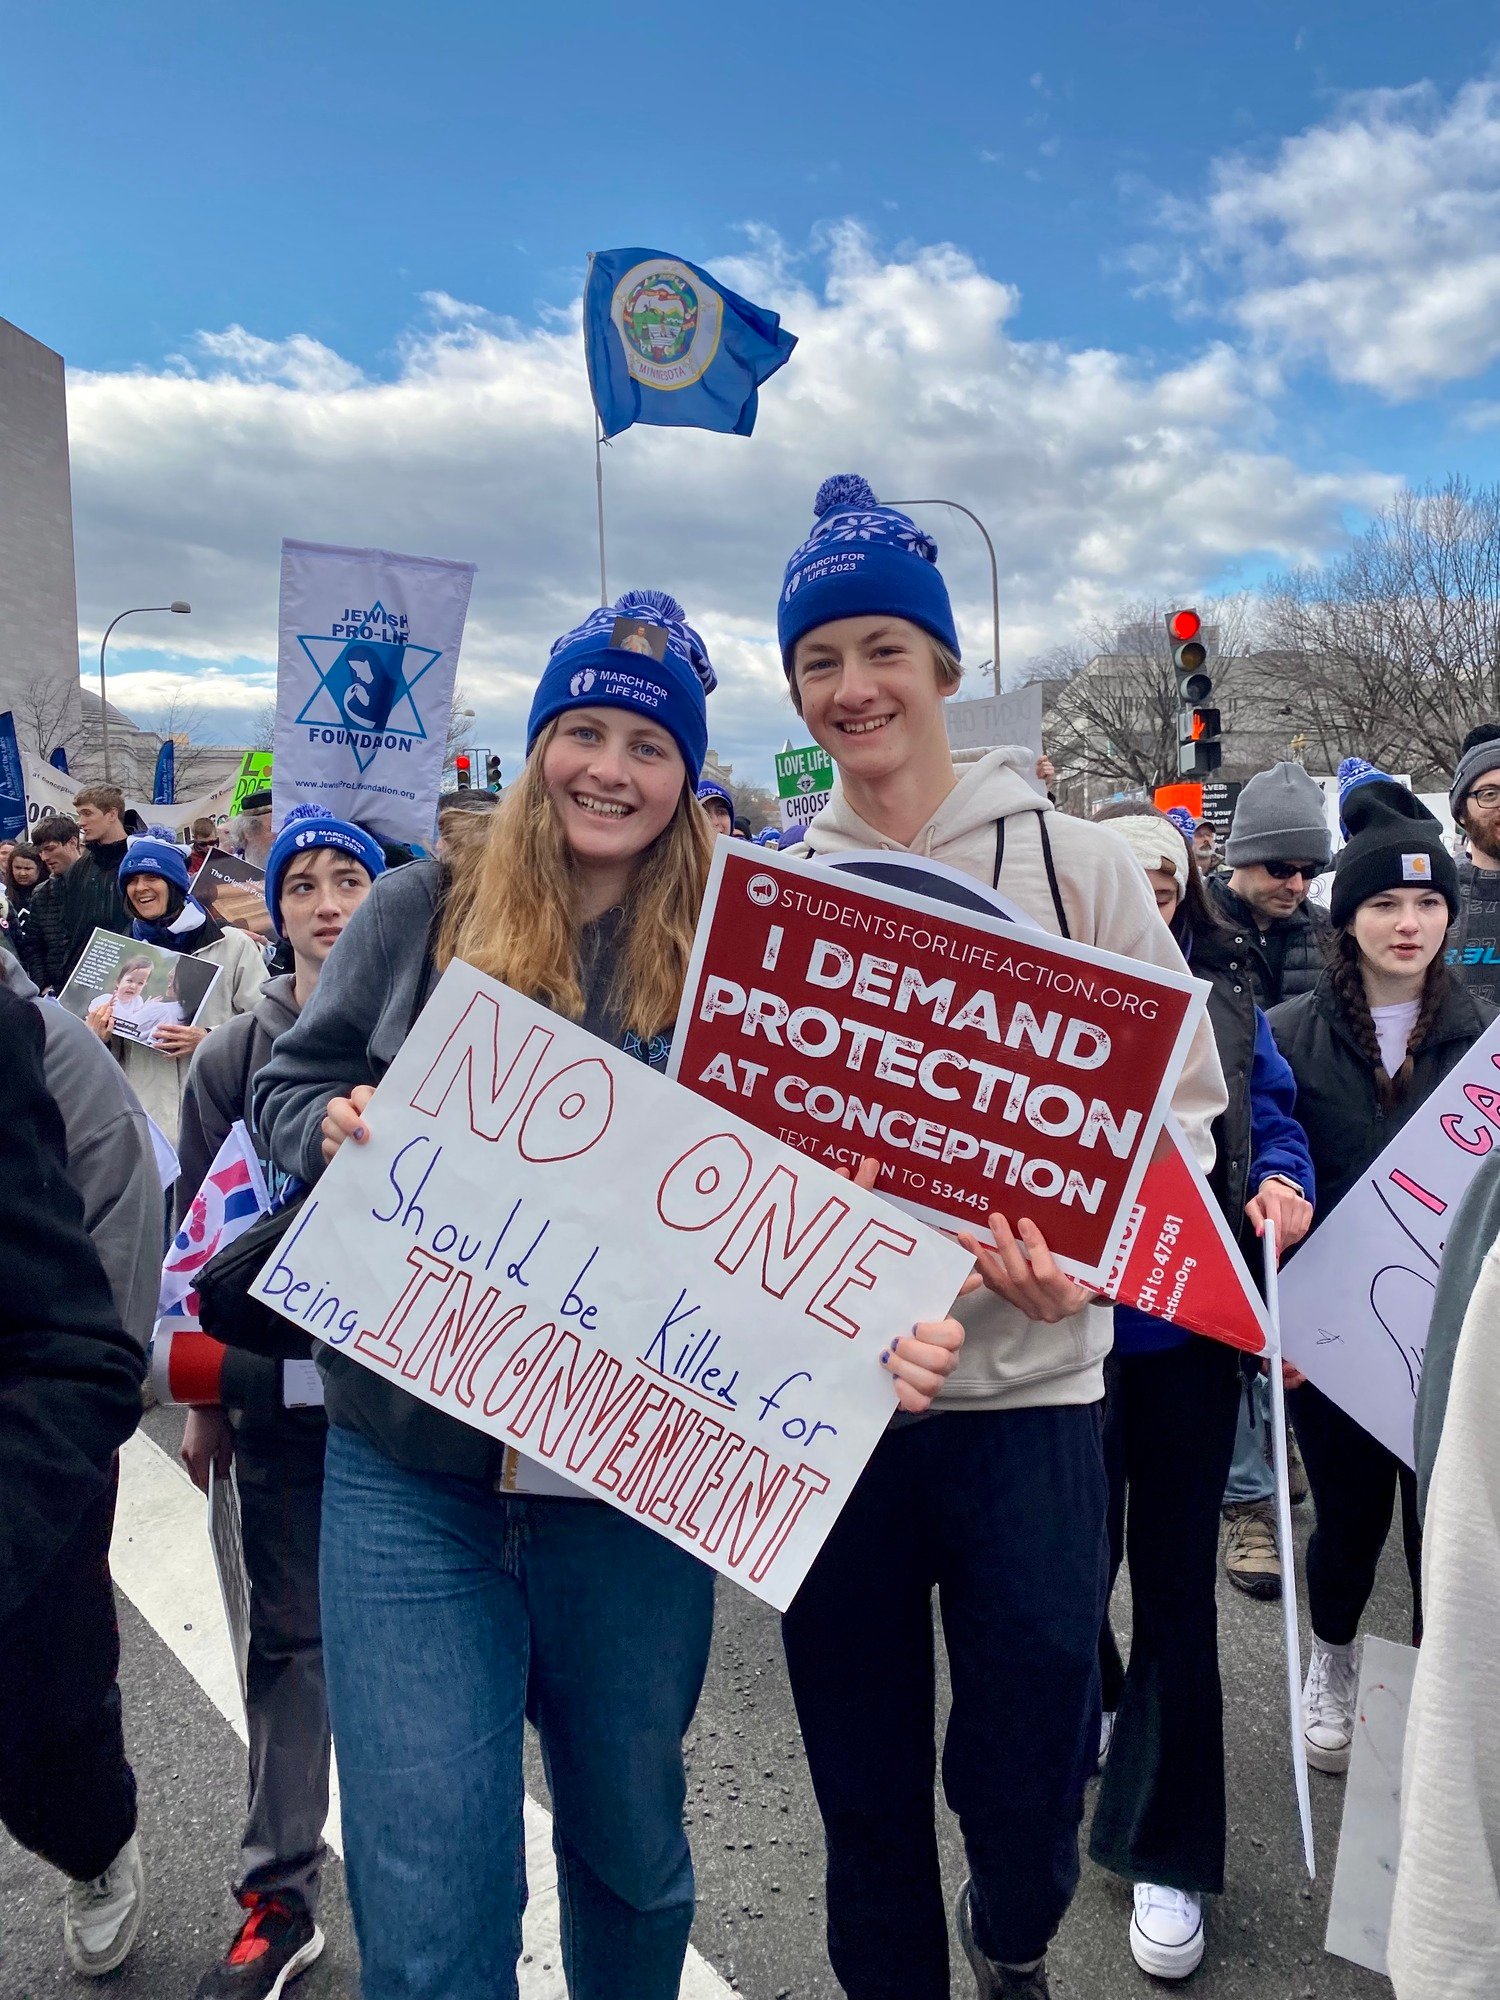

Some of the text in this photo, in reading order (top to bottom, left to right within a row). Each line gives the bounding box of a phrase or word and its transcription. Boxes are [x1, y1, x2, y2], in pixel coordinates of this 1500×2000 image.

[638, 363, 686, 381] MINNESOTA
[802, 553, 865, 576] MARCH FOR
[807, 562, 857, 582] LIFE 2023
[341, 608, 409, 629] JEWISH
[599, 670, 668, 700] MARCH FOR
[605, 683, 659, 707] LIFE 2023
[777, 750, 830, 778] LOVE LIFE
[786, 792, 830, 818] CHOOSE
[1213, 810, 1232, 818] your
[318, 830, 366, 853] MARCH FOR
[324, 836, 361, 854] LIFE 2023
[210, 868, 223, 879] The
[223, 875, 250, 892] Original
[780, 888, 1160, 1021] STUDENTSFORLIFEACTION.ORG
[761, 924, 1112, 1071] I DEMAND
[699, 974, 1143, 1160] PROTECTION
[699, 1052, 1107, 1215] AT CONCEPTION
[410, 991, 614, 1163] NO
[657, 1133, 916, 1339] ONE
[778, 1126, 990, 1211] TEXT ACTIN TO 53445
[1388, 1168, 1448, 1215] I
[1136, 1214, 1184, 1312] CH to 47581
[372, 1136, 837, 1448] Should be Killed for
[261, 1202, 360, 1344] being
[354, 1247, 830, 1583] INCONVENIENT
